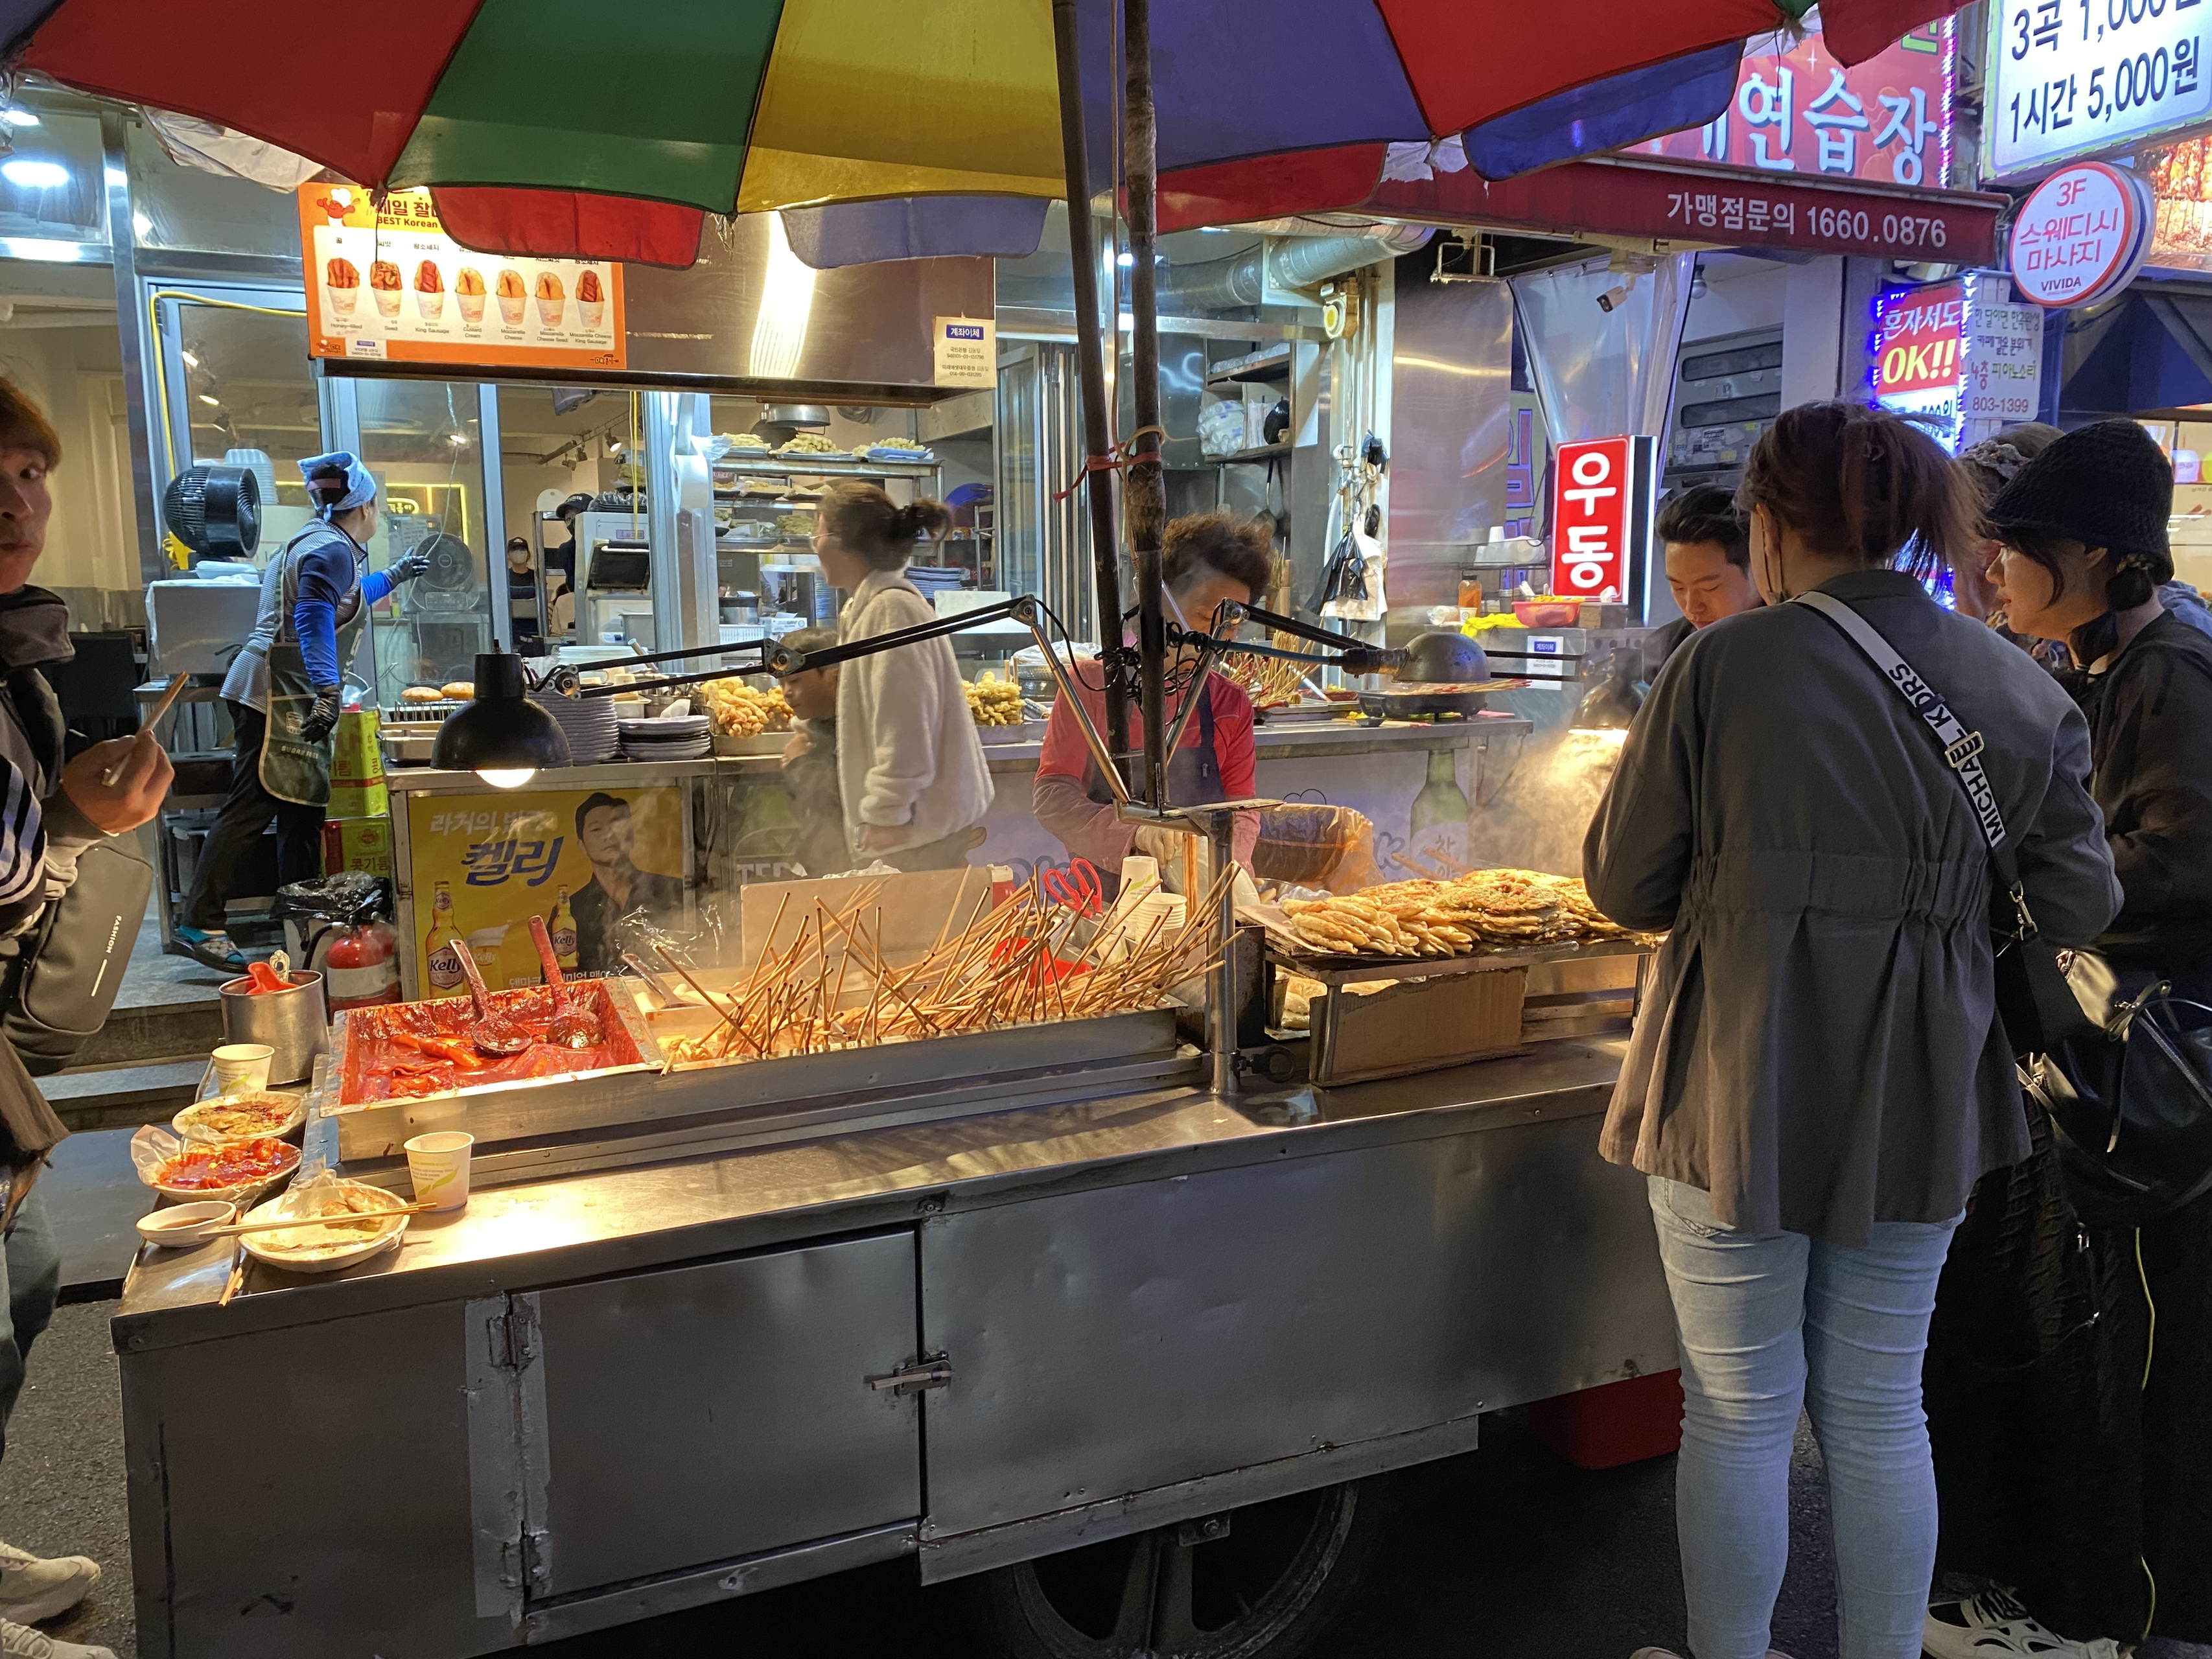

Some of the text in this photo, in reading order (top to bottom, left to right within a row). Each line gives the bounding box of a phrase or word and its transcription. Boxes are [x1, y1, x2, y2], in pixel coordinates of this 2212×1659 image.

[2012, 0, 2062, 60] 3곡
[2010, 36, 2200, 143] 1시간 5,000원
[2056, 178, 2087, 207] 3F
[378, 216, 438, 229] BEST Korean
[1668, 192, 1946, 248] 가맹점문의 1660.0876
[2020, 207, 2119, 246] 스웨디시
[2027, 238, 2101, 271] 마사지
[2042, 276, 2081, 291] VIVIDA
[951, 327, 980, 337] 계좌이체
[1883, 300, 1963, 341] 혼자서도
[1883, 339, 1957, 384] OK!!
[1971, 360, 1988, 390] 4층
[1973, 397, 2029, 413] 803-1399
[1561, 452, 1617, 588] 우동
[1950, 728, 2004, 842] MICHAL
[430, 811, 497, 836] 라거의
[351, 856, 388, 872] 콩기름
[461, 836, 565, 887] 켈리
[106, 915, 122, 953] FASHION
[554, 935, 575, 946] Kelly
[430, 958, 461, 974] Kelly
